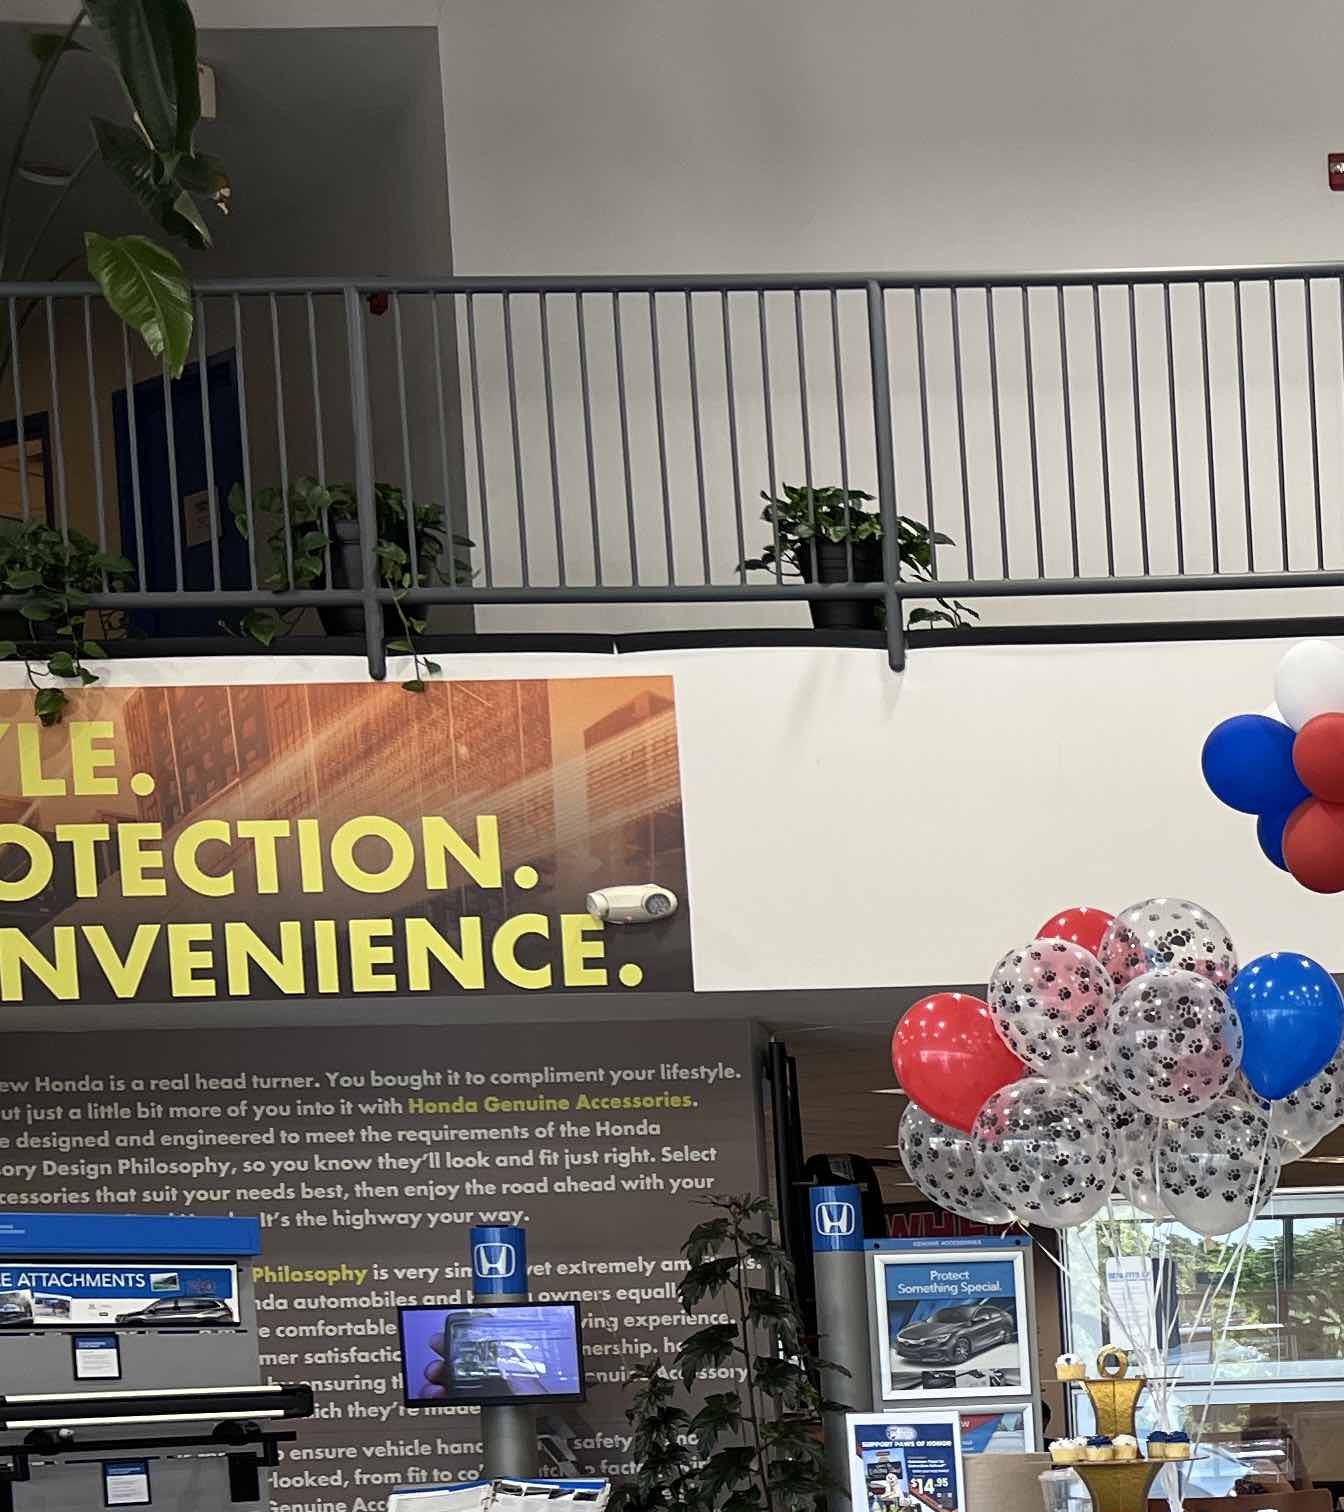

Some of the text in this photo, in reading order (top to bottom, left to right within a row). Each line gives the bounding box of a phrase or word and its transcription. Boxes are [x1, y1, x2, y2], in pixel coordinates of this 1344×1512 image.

[0, 721, 155, 796] LE.
[35, 1062, 741, 1093] Honda turner. bought compliment lifestyle.
[87, 1091, 698, 1119] little Honda Genuine Accessories.
[16, 1119, 661, 1152] designed engineered requirements Honda
[43, 1145, 717, 1179] Design Philosophy, right. Select
[236, 1174, 617, 1201] needs best, enjoy ahead
[332, 1209, 422, 1230] highway
[557, 1256, 655, 1277] extremely
[930, 1270, 970, 1280] Protect
[17, 1272, 146, 1288] ATTACHMENTS
[898, 1281, 1003, 1295] Something Special.
[275, 1319, 397, 1338] comfortable
[289, 1441, 432, 1461] ensure vehicle
